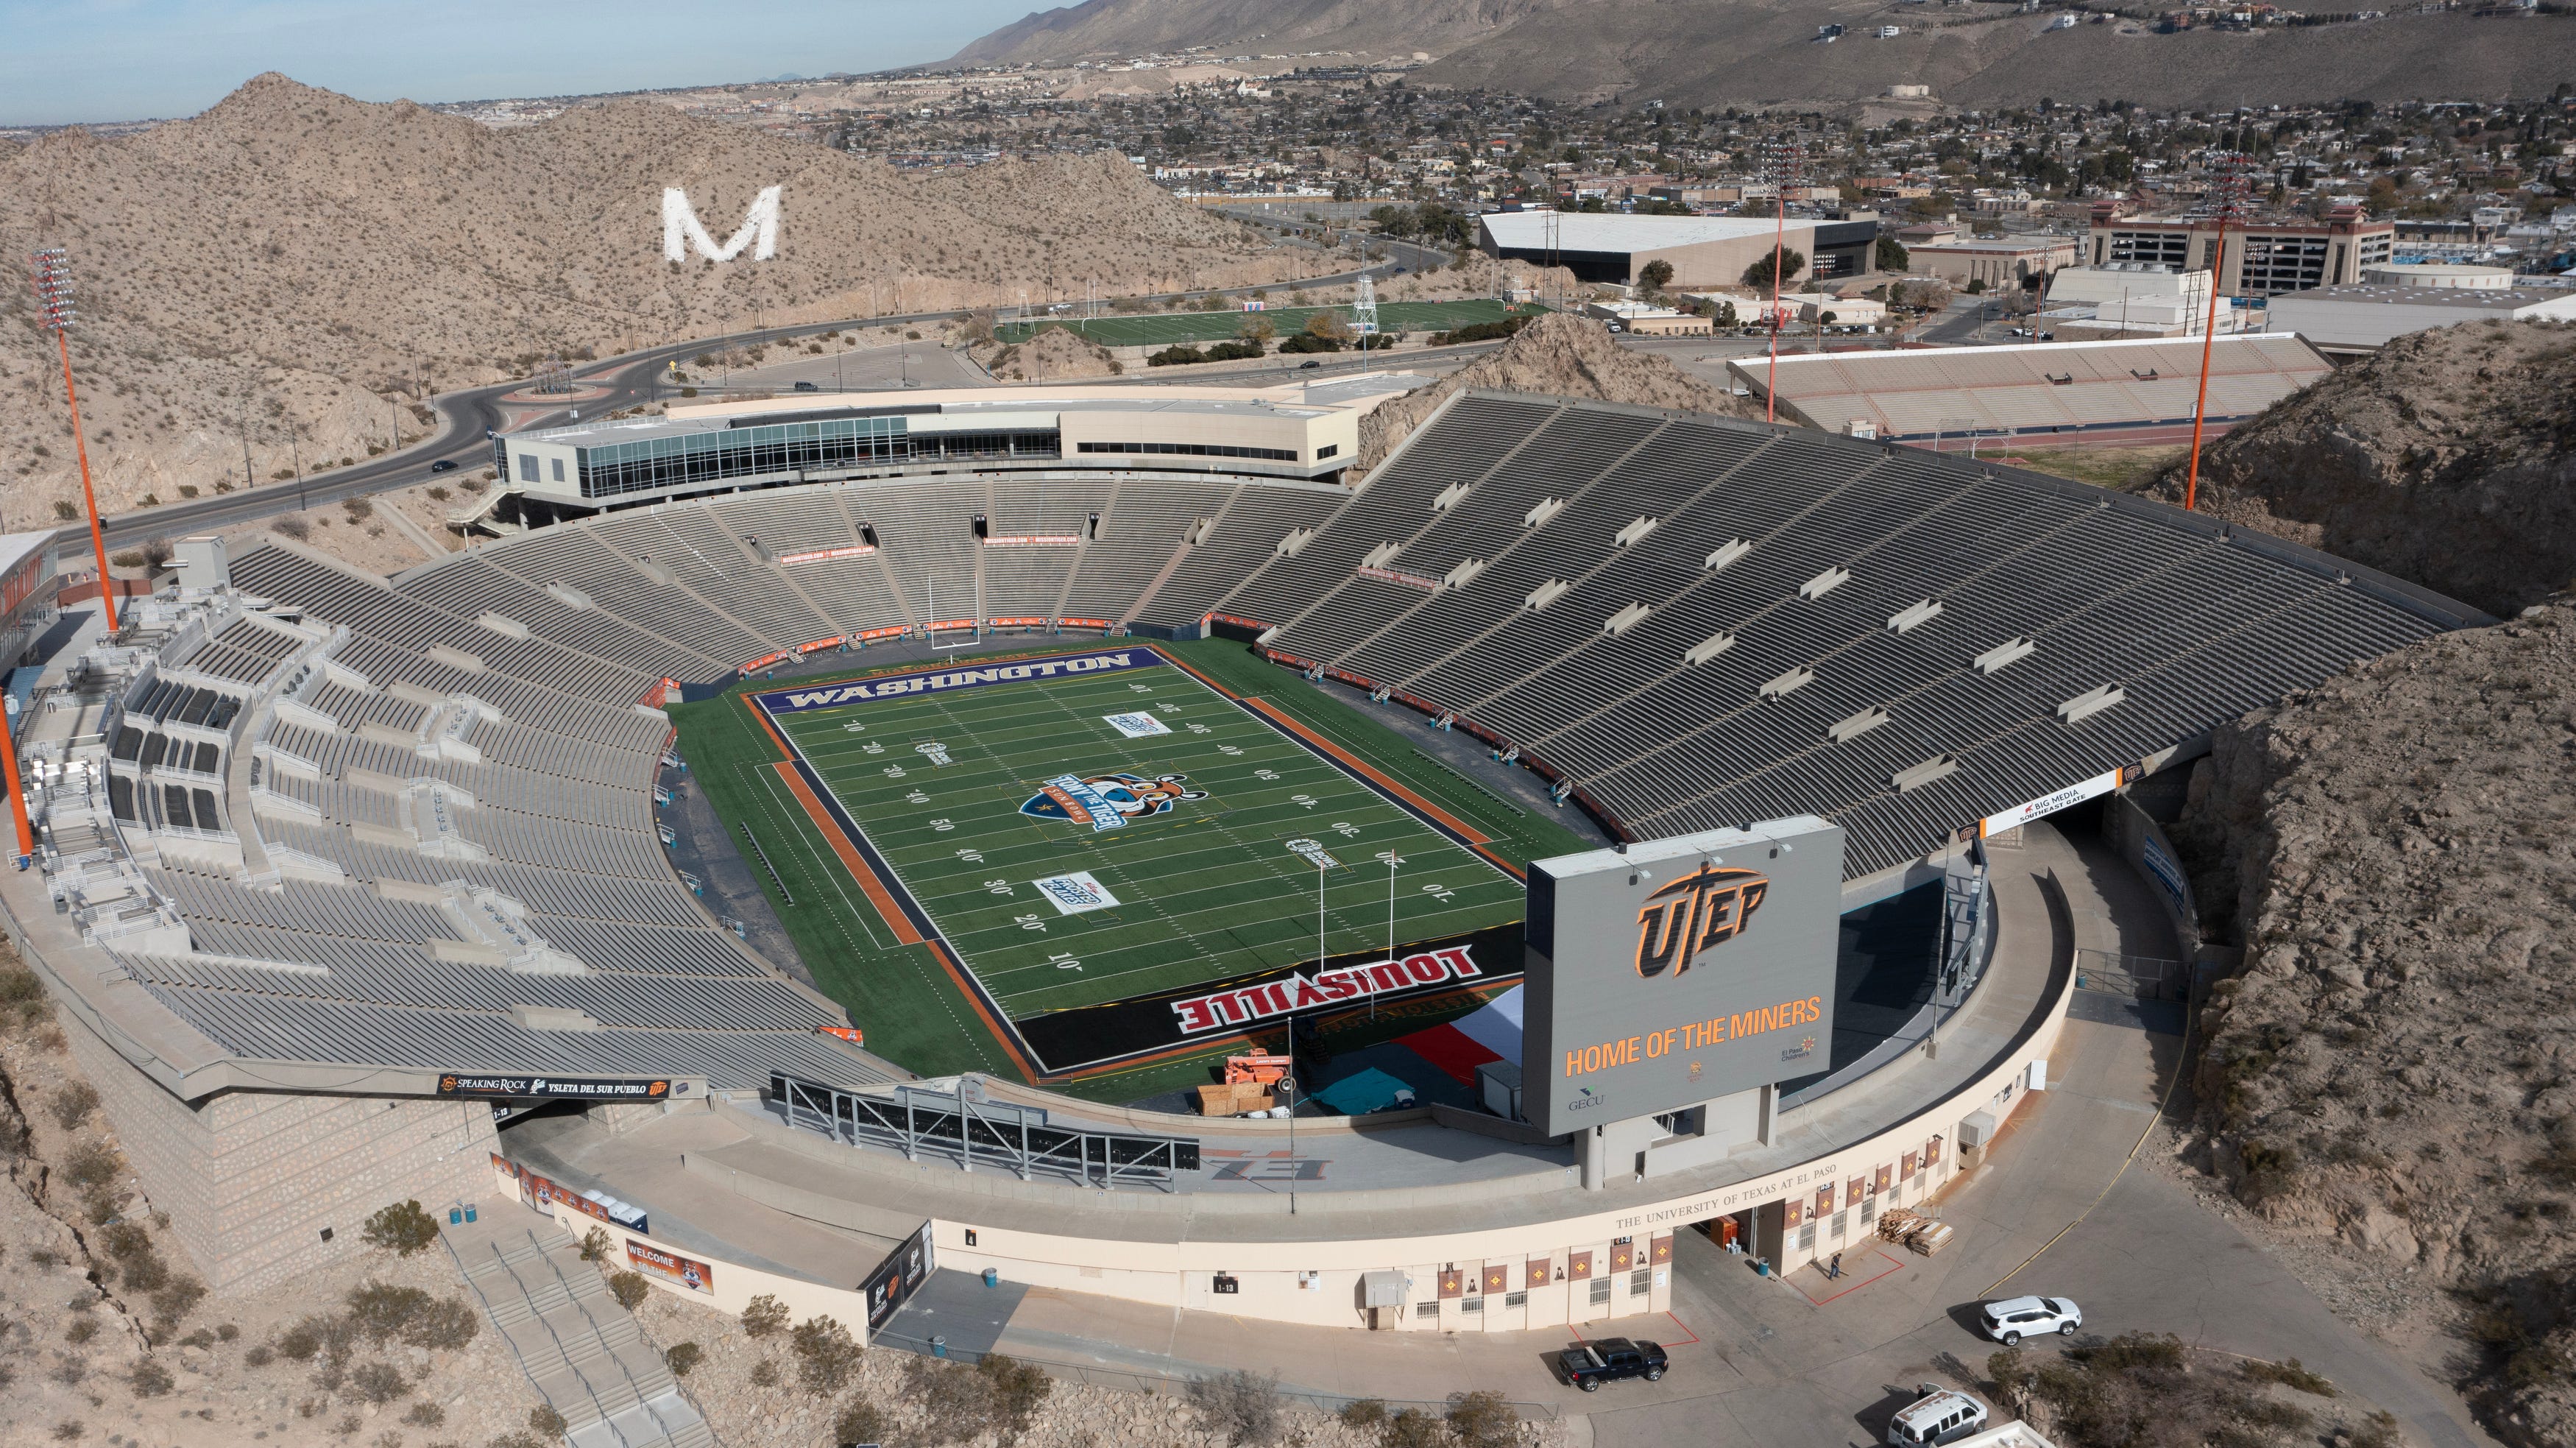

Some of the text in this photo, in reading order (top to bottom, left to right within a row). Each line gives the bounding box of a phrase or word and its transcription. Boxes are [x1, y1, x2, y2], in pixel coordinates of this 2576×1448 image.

[664, 185, 781, 261] M
[786, 654, 1130, 707] WASHINGTON
[1130, 685, 1153, 693] 10
[1158, 704, 1181, 713] 20
[843, 721, 865, 732] 10
[1189, 724, 1212, 734] 30
[862, 744, 885, 754] 20
[1220, 745, 1244, 755] 40
[884, 767, 907, 778] 30
[1254, 769, 1280, 780] 50
[905, 791, 930, 804] 40
[1049, 788, 1087, 820] SUN BOWL
[1055, 776, 1122, 828] TONY THE TIGER
[1292, 794, 1317, 806] 40
[2035, 789, 2079, 810] BIG MEDIA
[2020, 794, 2086, 822] SOUTHEAST GATE
[930, 819, 955, 831] 50
[1331, 822, 1359, 835] 30
[956, 849, 980, 862] 40
[1375, 852, 1406, 865] 20
[984, 878, 1011, 894] 30
[1052, 879, 1102, 904] FROSTED
[1422, 884, 1455, 899] 10
[1041, 883, 1084, 905] FLAKES
[1014, 914, 1042, 930] 20
[1635, 863, 1769, 978] UTEP
[1049, 952, 1079, 970] 10
[1172, 944, 1482, 1034] LOUISVILLE
[1565, 996, 1822, 1077] HOME OF THE MINERS
[1781, 1051, 1810, 1062] Children's
[1788, 1048, 1802, 1056] Paso
[457, 1078, 526, 1093] SPEAKING ROCK
[548, 1084, 646, 1094] YSLETA DEL SUR PUEBLO
[649, 1081, 668, 1095] UTEP
[1569, 1095, 1604, 1111] GECU
[494, 1107, 509, 1119] 1-13
[1616, 1165, 1837, 1229] THE UNIVERSITY OF TEXAS AT EL PASO
[969, 1236, 974, 1245] 4
[628, 1244, 674, 1267] WELCOME
[637, 1261, 668, 1278] TO THE
[1218, 1284, 1234, 1292] 1-13
